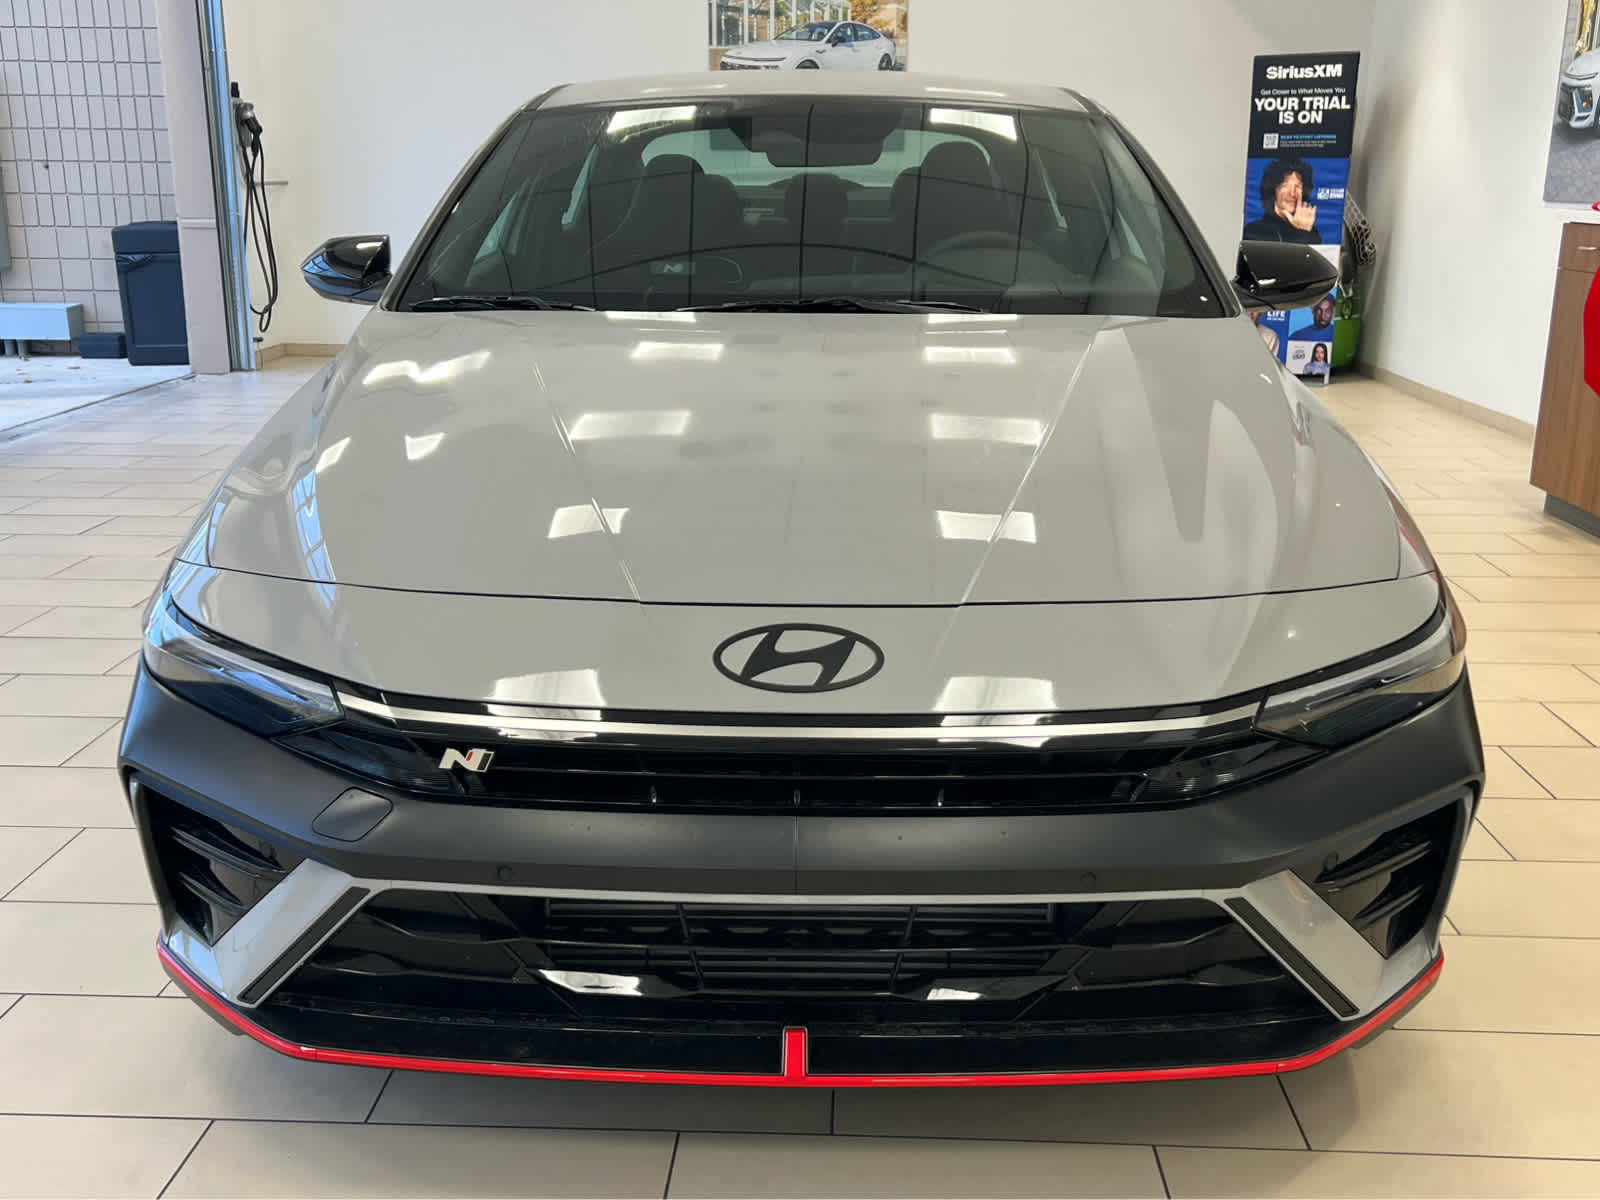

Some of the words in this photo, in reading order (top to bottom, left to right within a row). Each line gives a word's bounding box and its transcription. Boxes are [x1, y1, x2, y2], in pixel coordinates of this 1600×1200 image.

[1266, 64, 1343, 79] SiriusXM
[1254, 97, 1299, 111] YOUR
[1302, 96, 1351, 110] TRIAL
[1278, 112, 1294, 124] IS
[1297, 111, 1323, 124] ON
